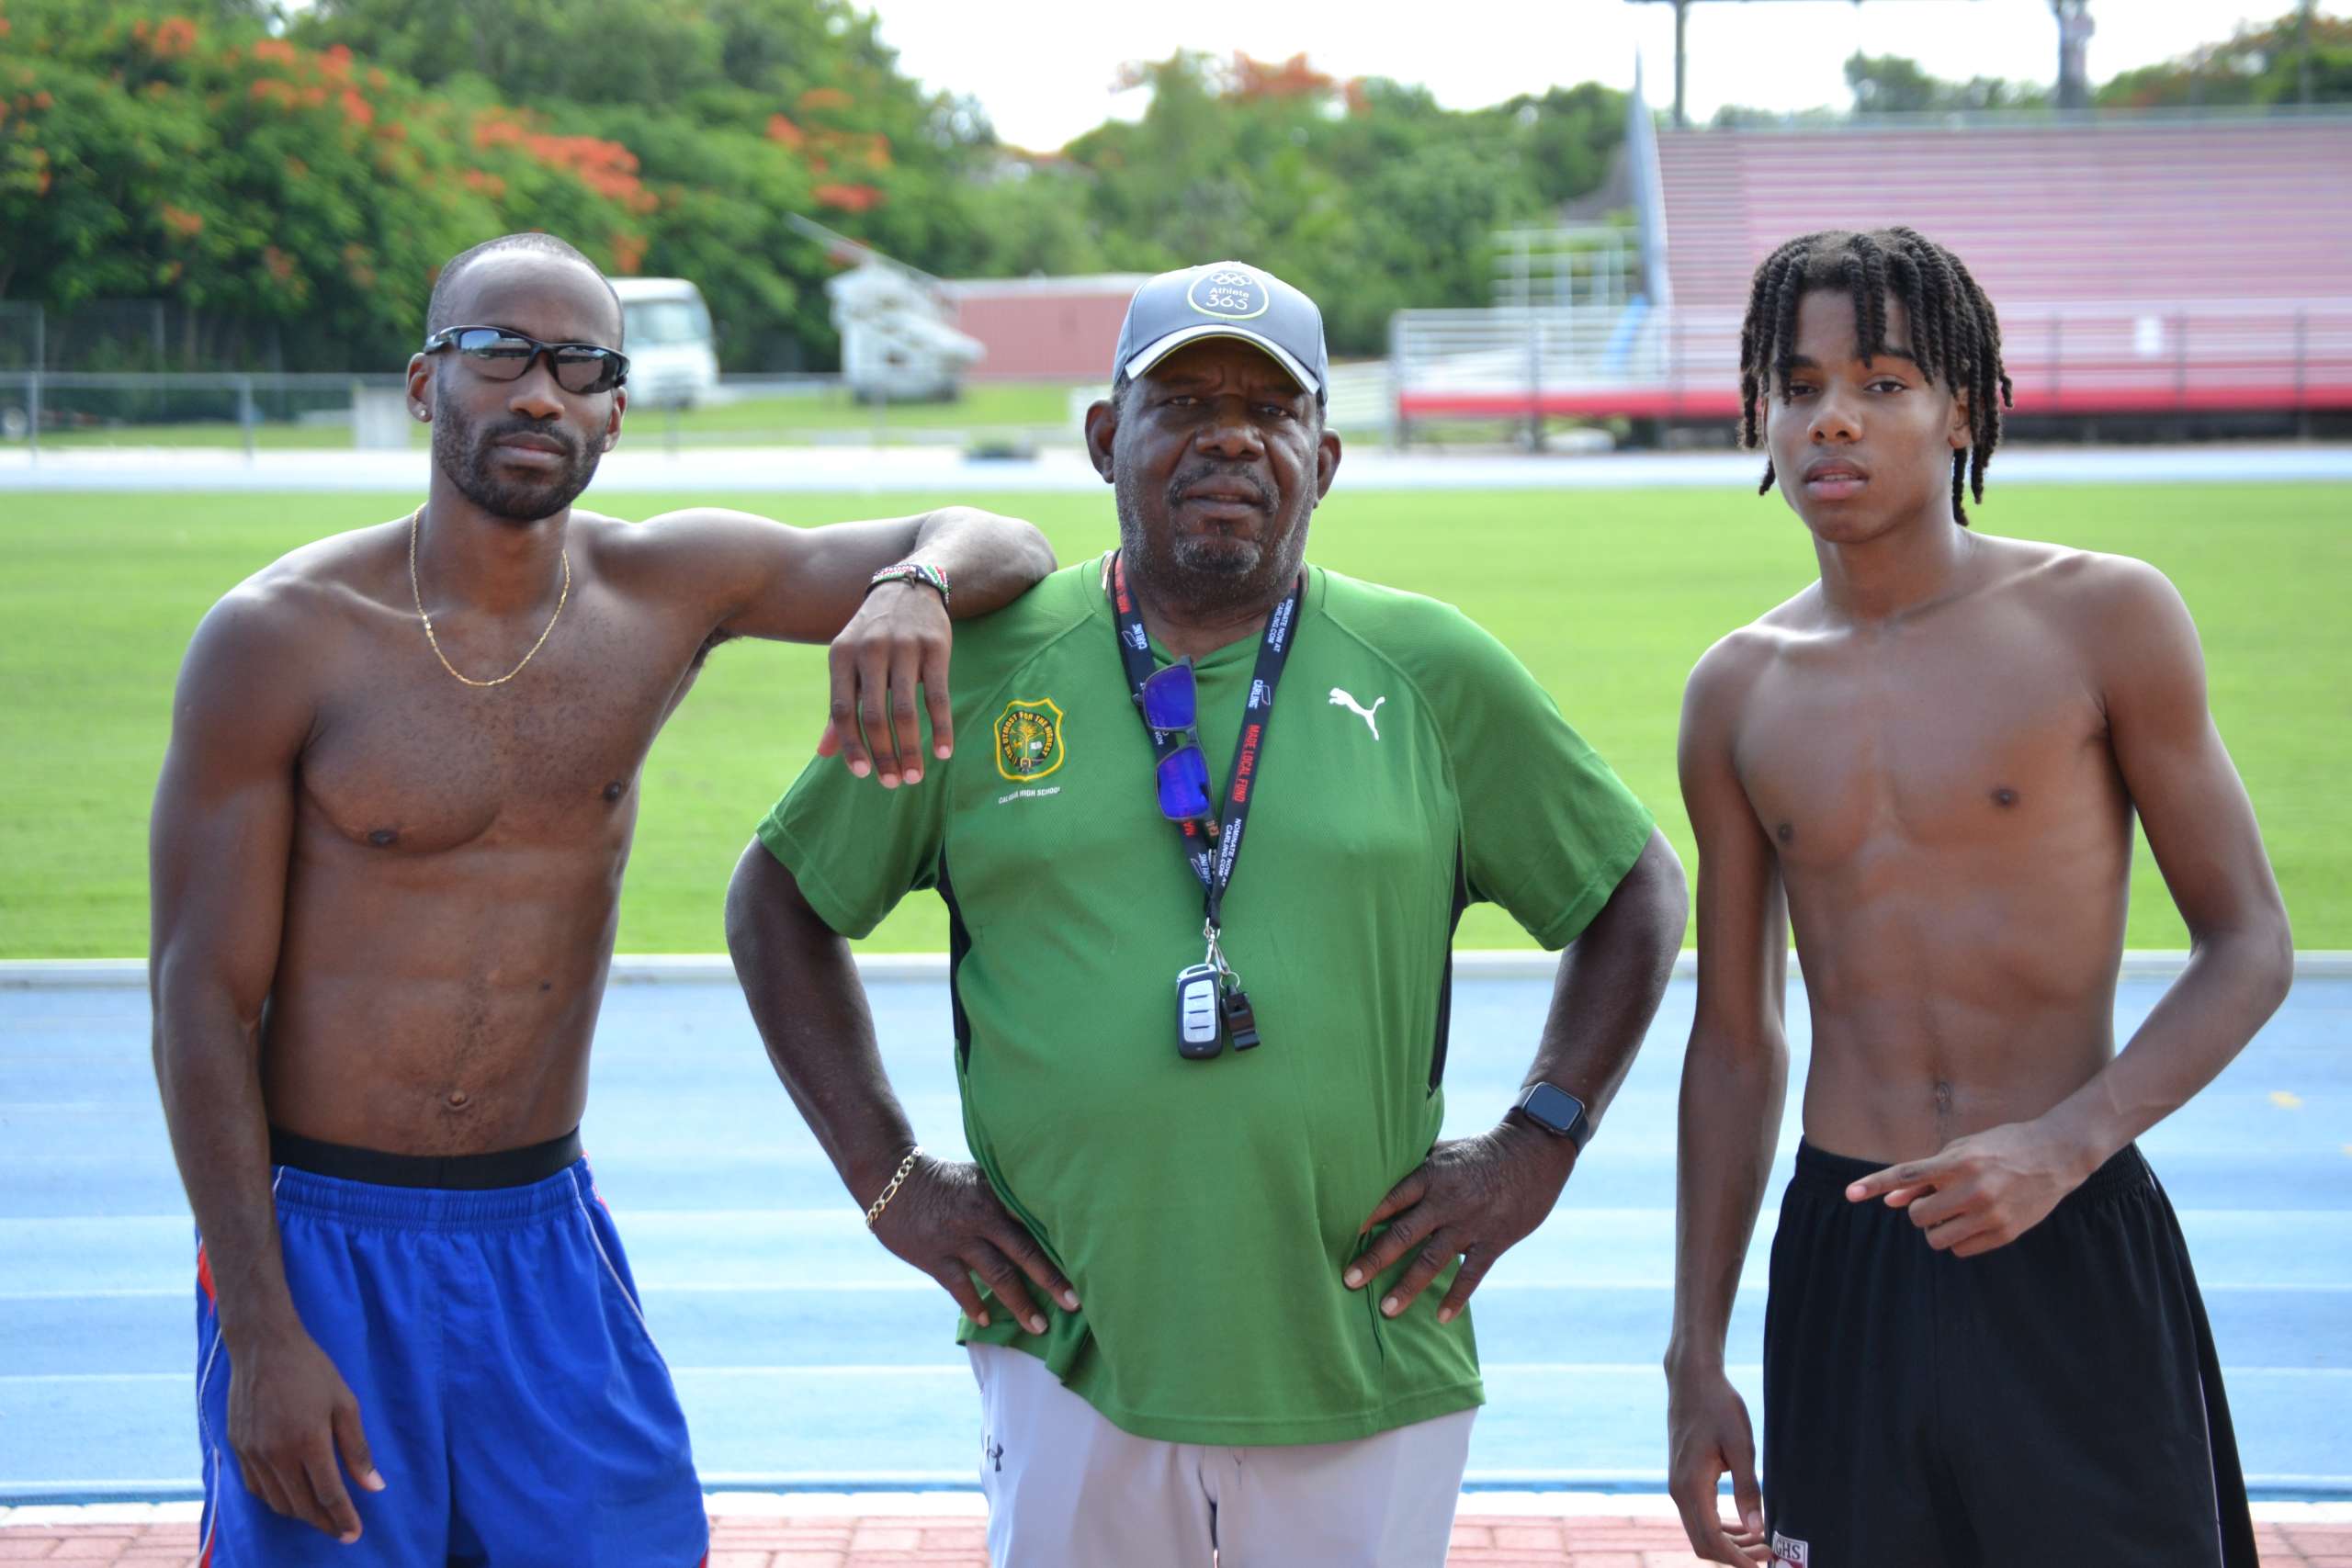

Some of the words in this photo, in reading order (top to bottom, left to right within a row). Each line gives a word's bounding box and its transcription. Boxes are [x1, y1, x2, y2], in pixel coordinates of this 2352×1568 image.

[1205, 294, 1249, 310] 365
[1209, 287, 1250, 299] Athlete
[1280, 598, 1294, 627] NOMINATE
[1132, 623, 1148, 650] CARLING
[1273, 643, 1282, 653] AT
[1275, 627, 1285, 644] NOW
[1248, 679, 1263, 709] CARLING
[1244, 724, 1261, 749] MADE
[1238, 750, 1253, 778] LOCAL
[1233, 778, 1248, 802] FUND
[1218, 824, 1233, 877] CARLING.COM
[1228, 818, 1242, 858] NOMINATE
[1223, 857, 1233, 878] NOW
